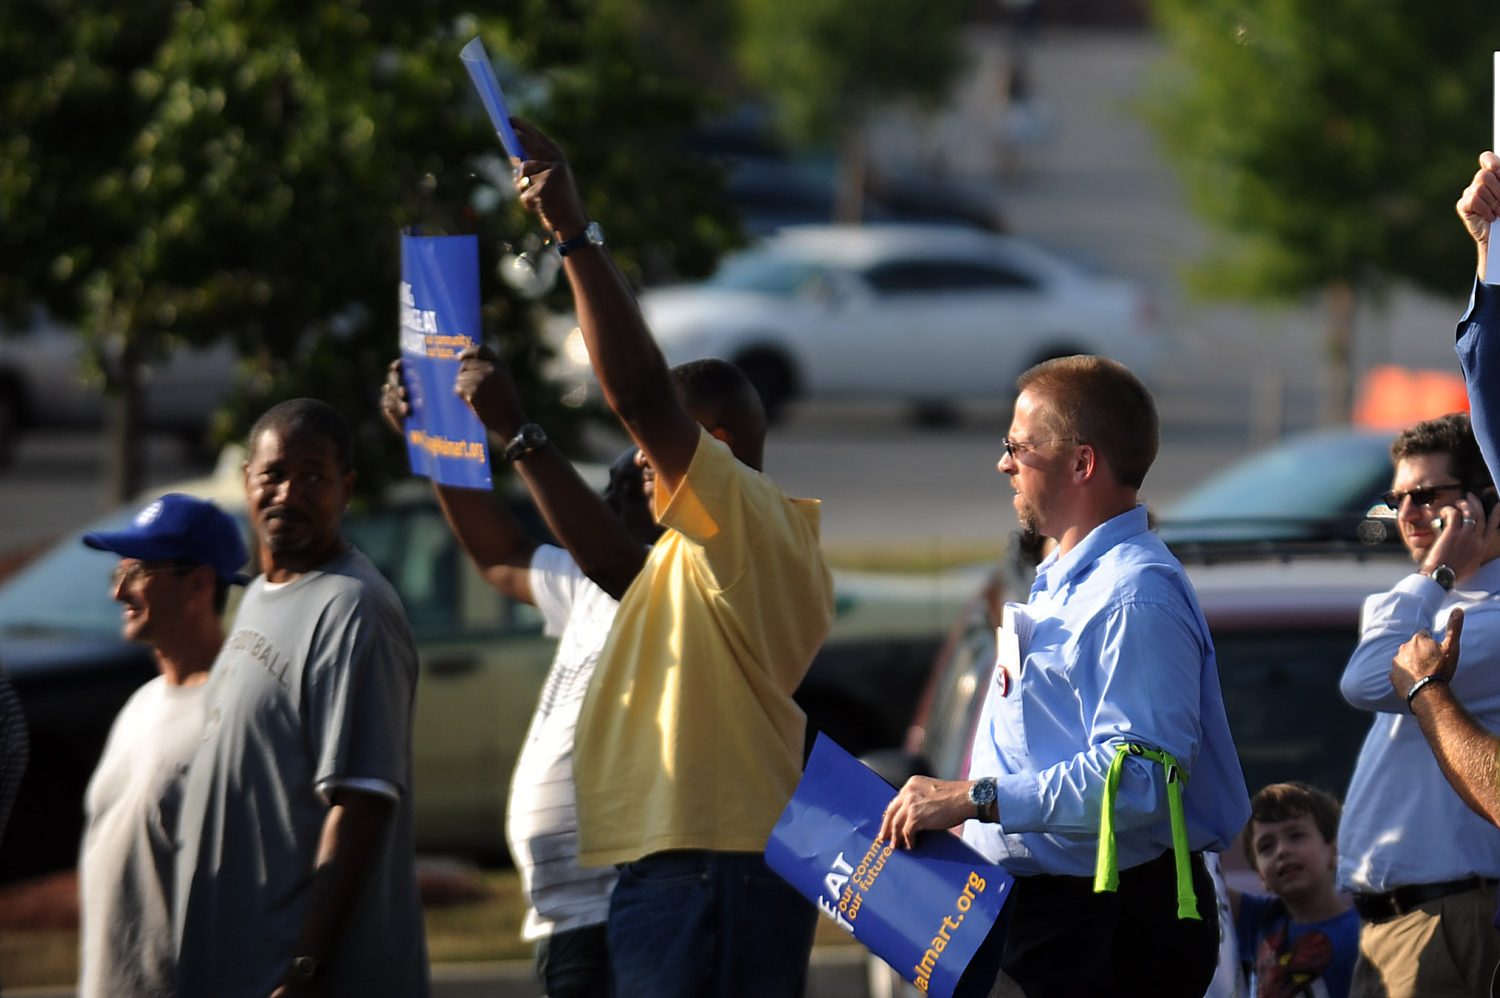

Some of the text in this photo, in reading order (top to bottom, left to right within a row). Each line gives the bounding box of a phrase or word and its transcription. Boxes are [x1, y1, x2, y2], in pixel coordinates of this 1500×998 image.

[824, 851, 855, 901] AT
[838, 884, 854, 913] our
[848, 892, 864, 920] our
